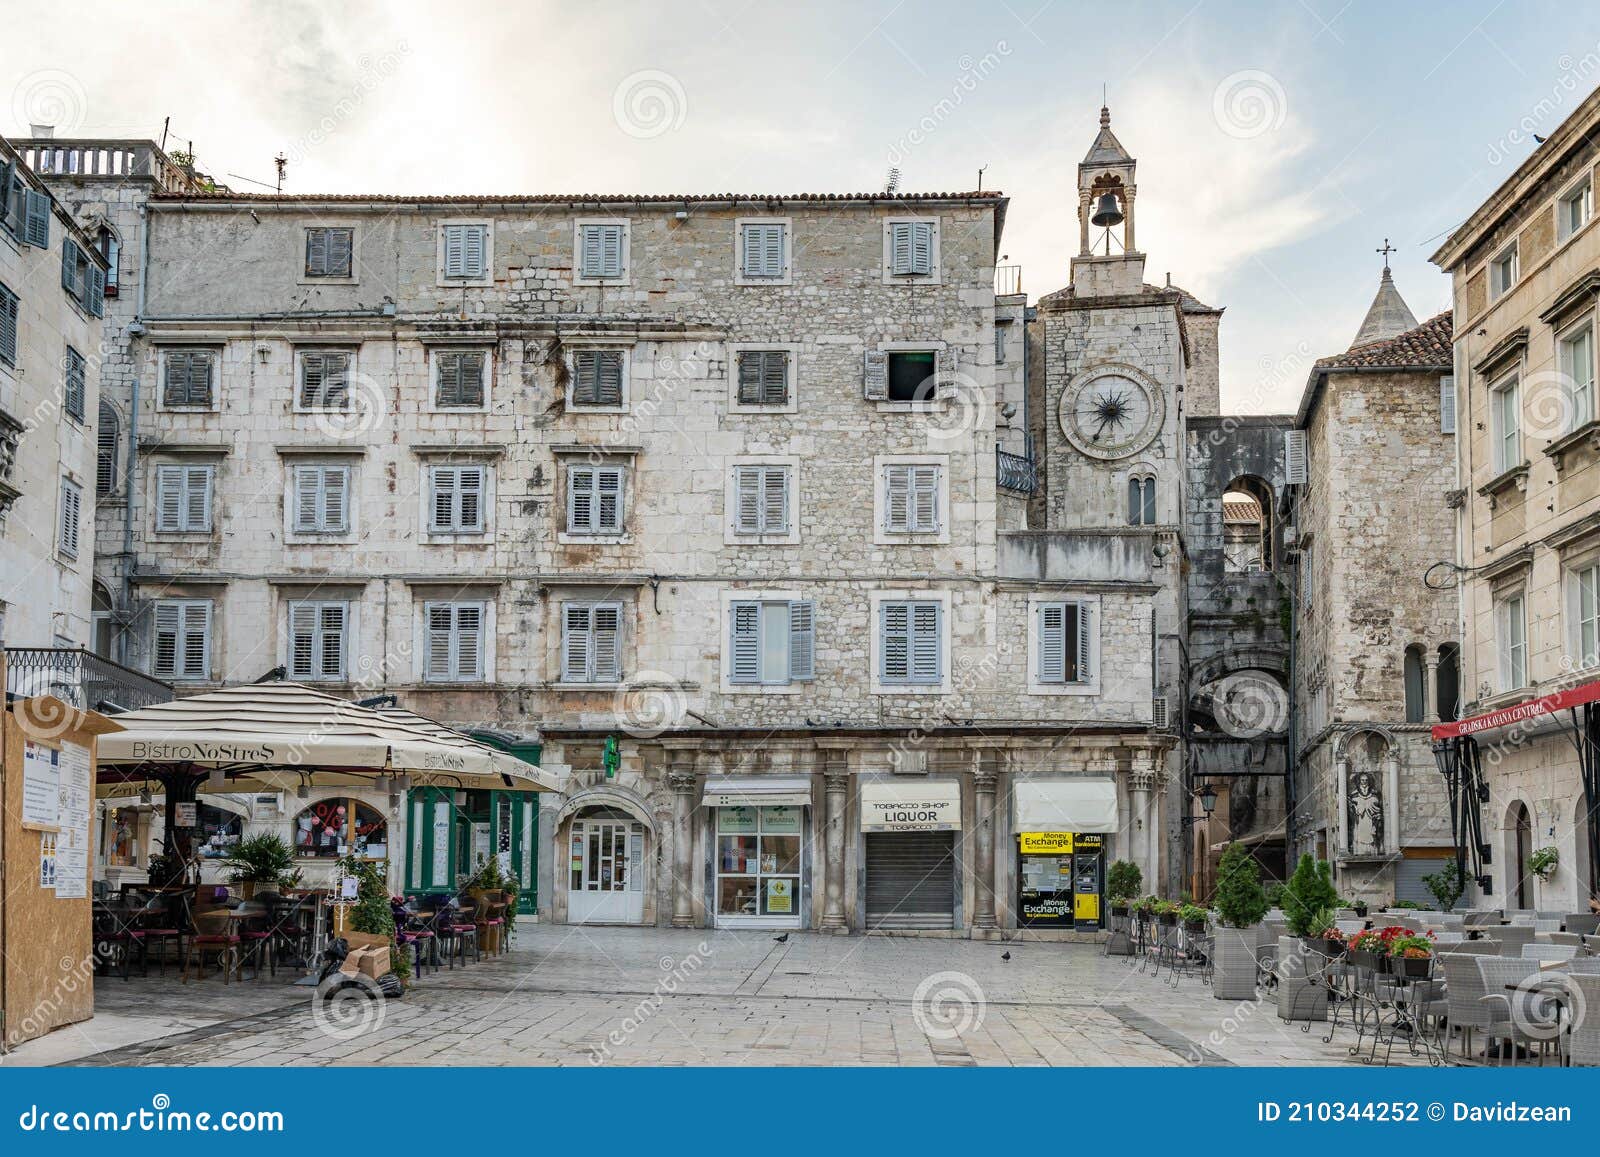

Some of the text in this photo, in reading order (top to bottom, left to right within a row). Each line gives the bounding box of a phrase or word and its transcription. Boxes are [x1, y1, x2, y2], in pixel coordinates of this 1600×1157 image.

[1459, 702, 1545, 734] GRADSKA KAVANA CENTRAL
[885, 811, 938, 822] LIQUOR
